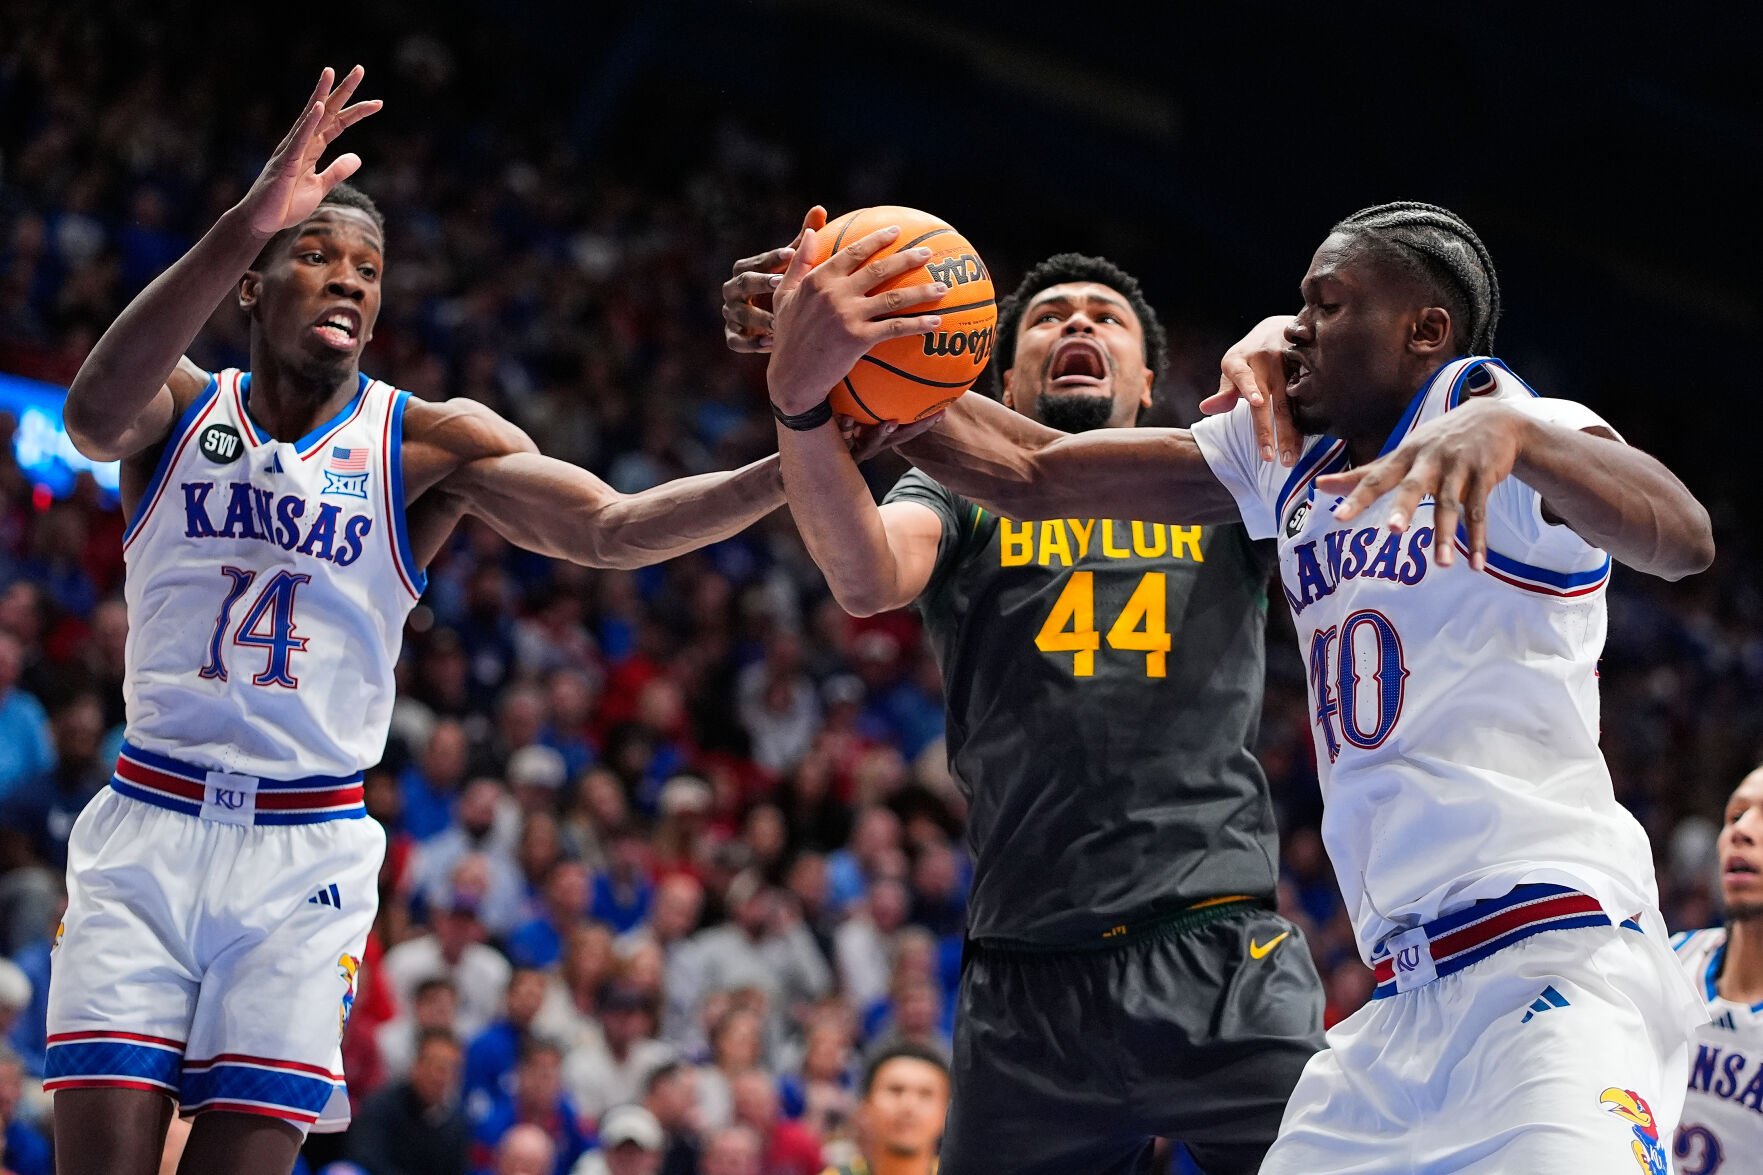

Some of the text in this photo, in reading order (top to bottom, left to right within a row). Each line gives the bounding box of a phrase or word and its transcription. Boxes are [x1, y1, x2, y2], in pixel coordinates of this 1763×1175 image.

[922, 325, 995, 365] ilson
[204, 430, 239, 457] SW
[181, 481, 373, 567] KANSAS
[1000, 516, 1204, 567] BAYLOR
[199, 566, 311, 689] 14
[1034, 571, 1171, 678] 44
[1310, 608, 1411, 764] 40
[214, 788, 247, 810] KU
[1397, 944, 1420, 973] KU
[1688, 1044, 1763, 1114] NSA
